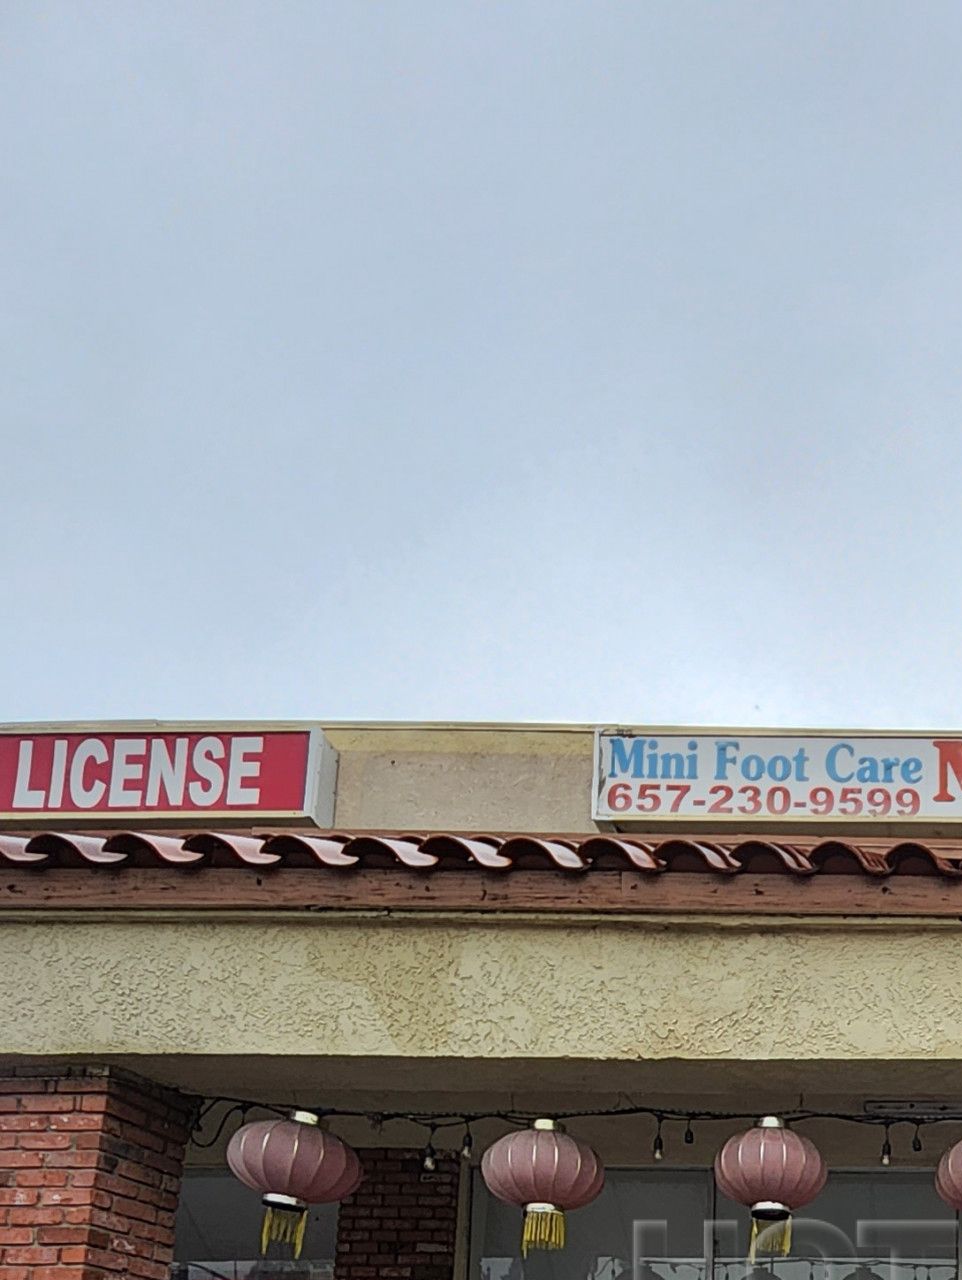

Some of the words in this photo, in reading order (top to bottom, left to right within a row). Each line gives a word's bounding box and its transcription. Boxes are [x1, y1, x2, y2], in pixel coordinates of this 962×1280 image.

[12, 736, 264, 809] LICENSE
[609, 738, 699, 780] Mini
[714, 740, 809, 782] Foot
[825, 743, 923, 784] Care
[607, 783, 921, 817] 657-230-9599
